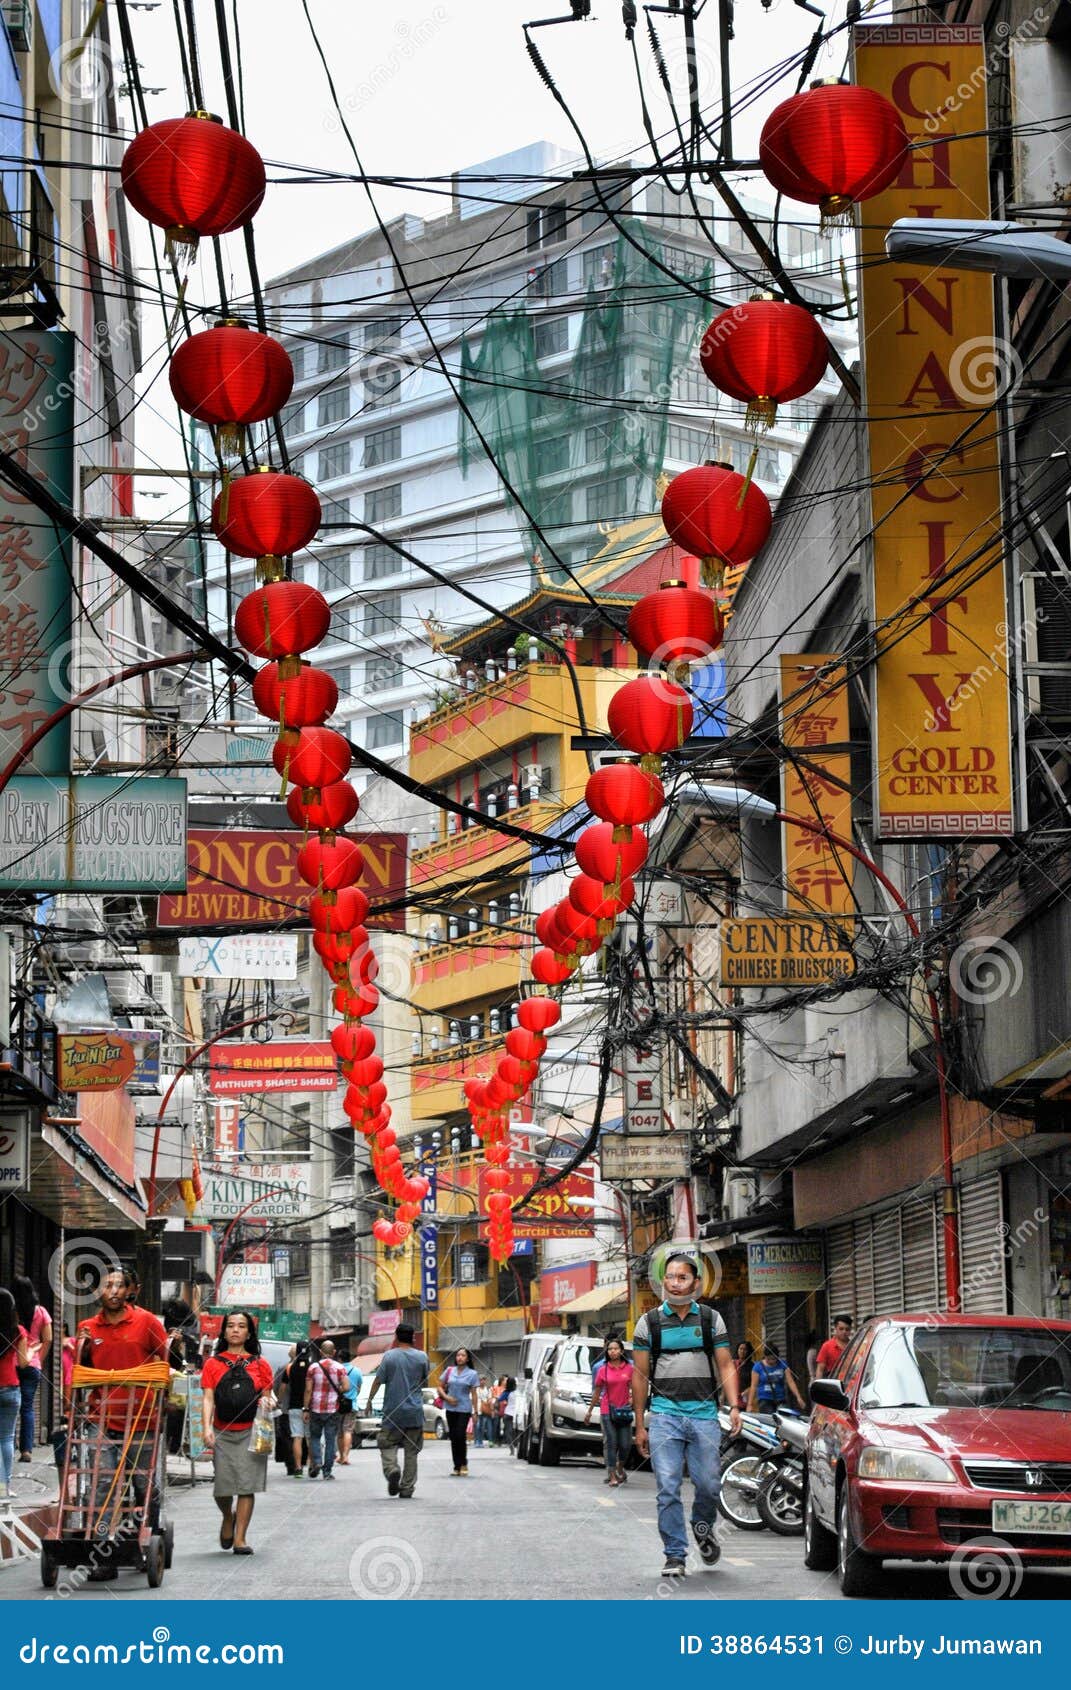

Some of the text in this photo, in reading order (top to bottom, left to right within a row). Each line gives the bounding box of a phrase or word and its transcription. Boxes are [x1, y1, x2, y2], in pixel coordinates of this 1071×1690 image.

[891, 61, 966, 409] CHNA
[892, 747, 995, 774] GOLD
[888, 775, 999, 796] CENTER
[3, 788, 182, 846] REN DRUGSTORE
[58, 850, 180, 882] MERCHANDISE
[171, 893, 288, 920] JEWELRY
[726, 923, 853, 953] CENTRAL
[727, 957, 777, 979] CHINESE
[214, 1077, 333, 1089] ARTHUR'S SHABU SHABU
[630, 1115, 659, 1127] 1047
[212, 1180, 246, 1202] KIM
[252, 1203, 300, 1215] GARDEN
[424, 1240, 437, 1301] GOLD
